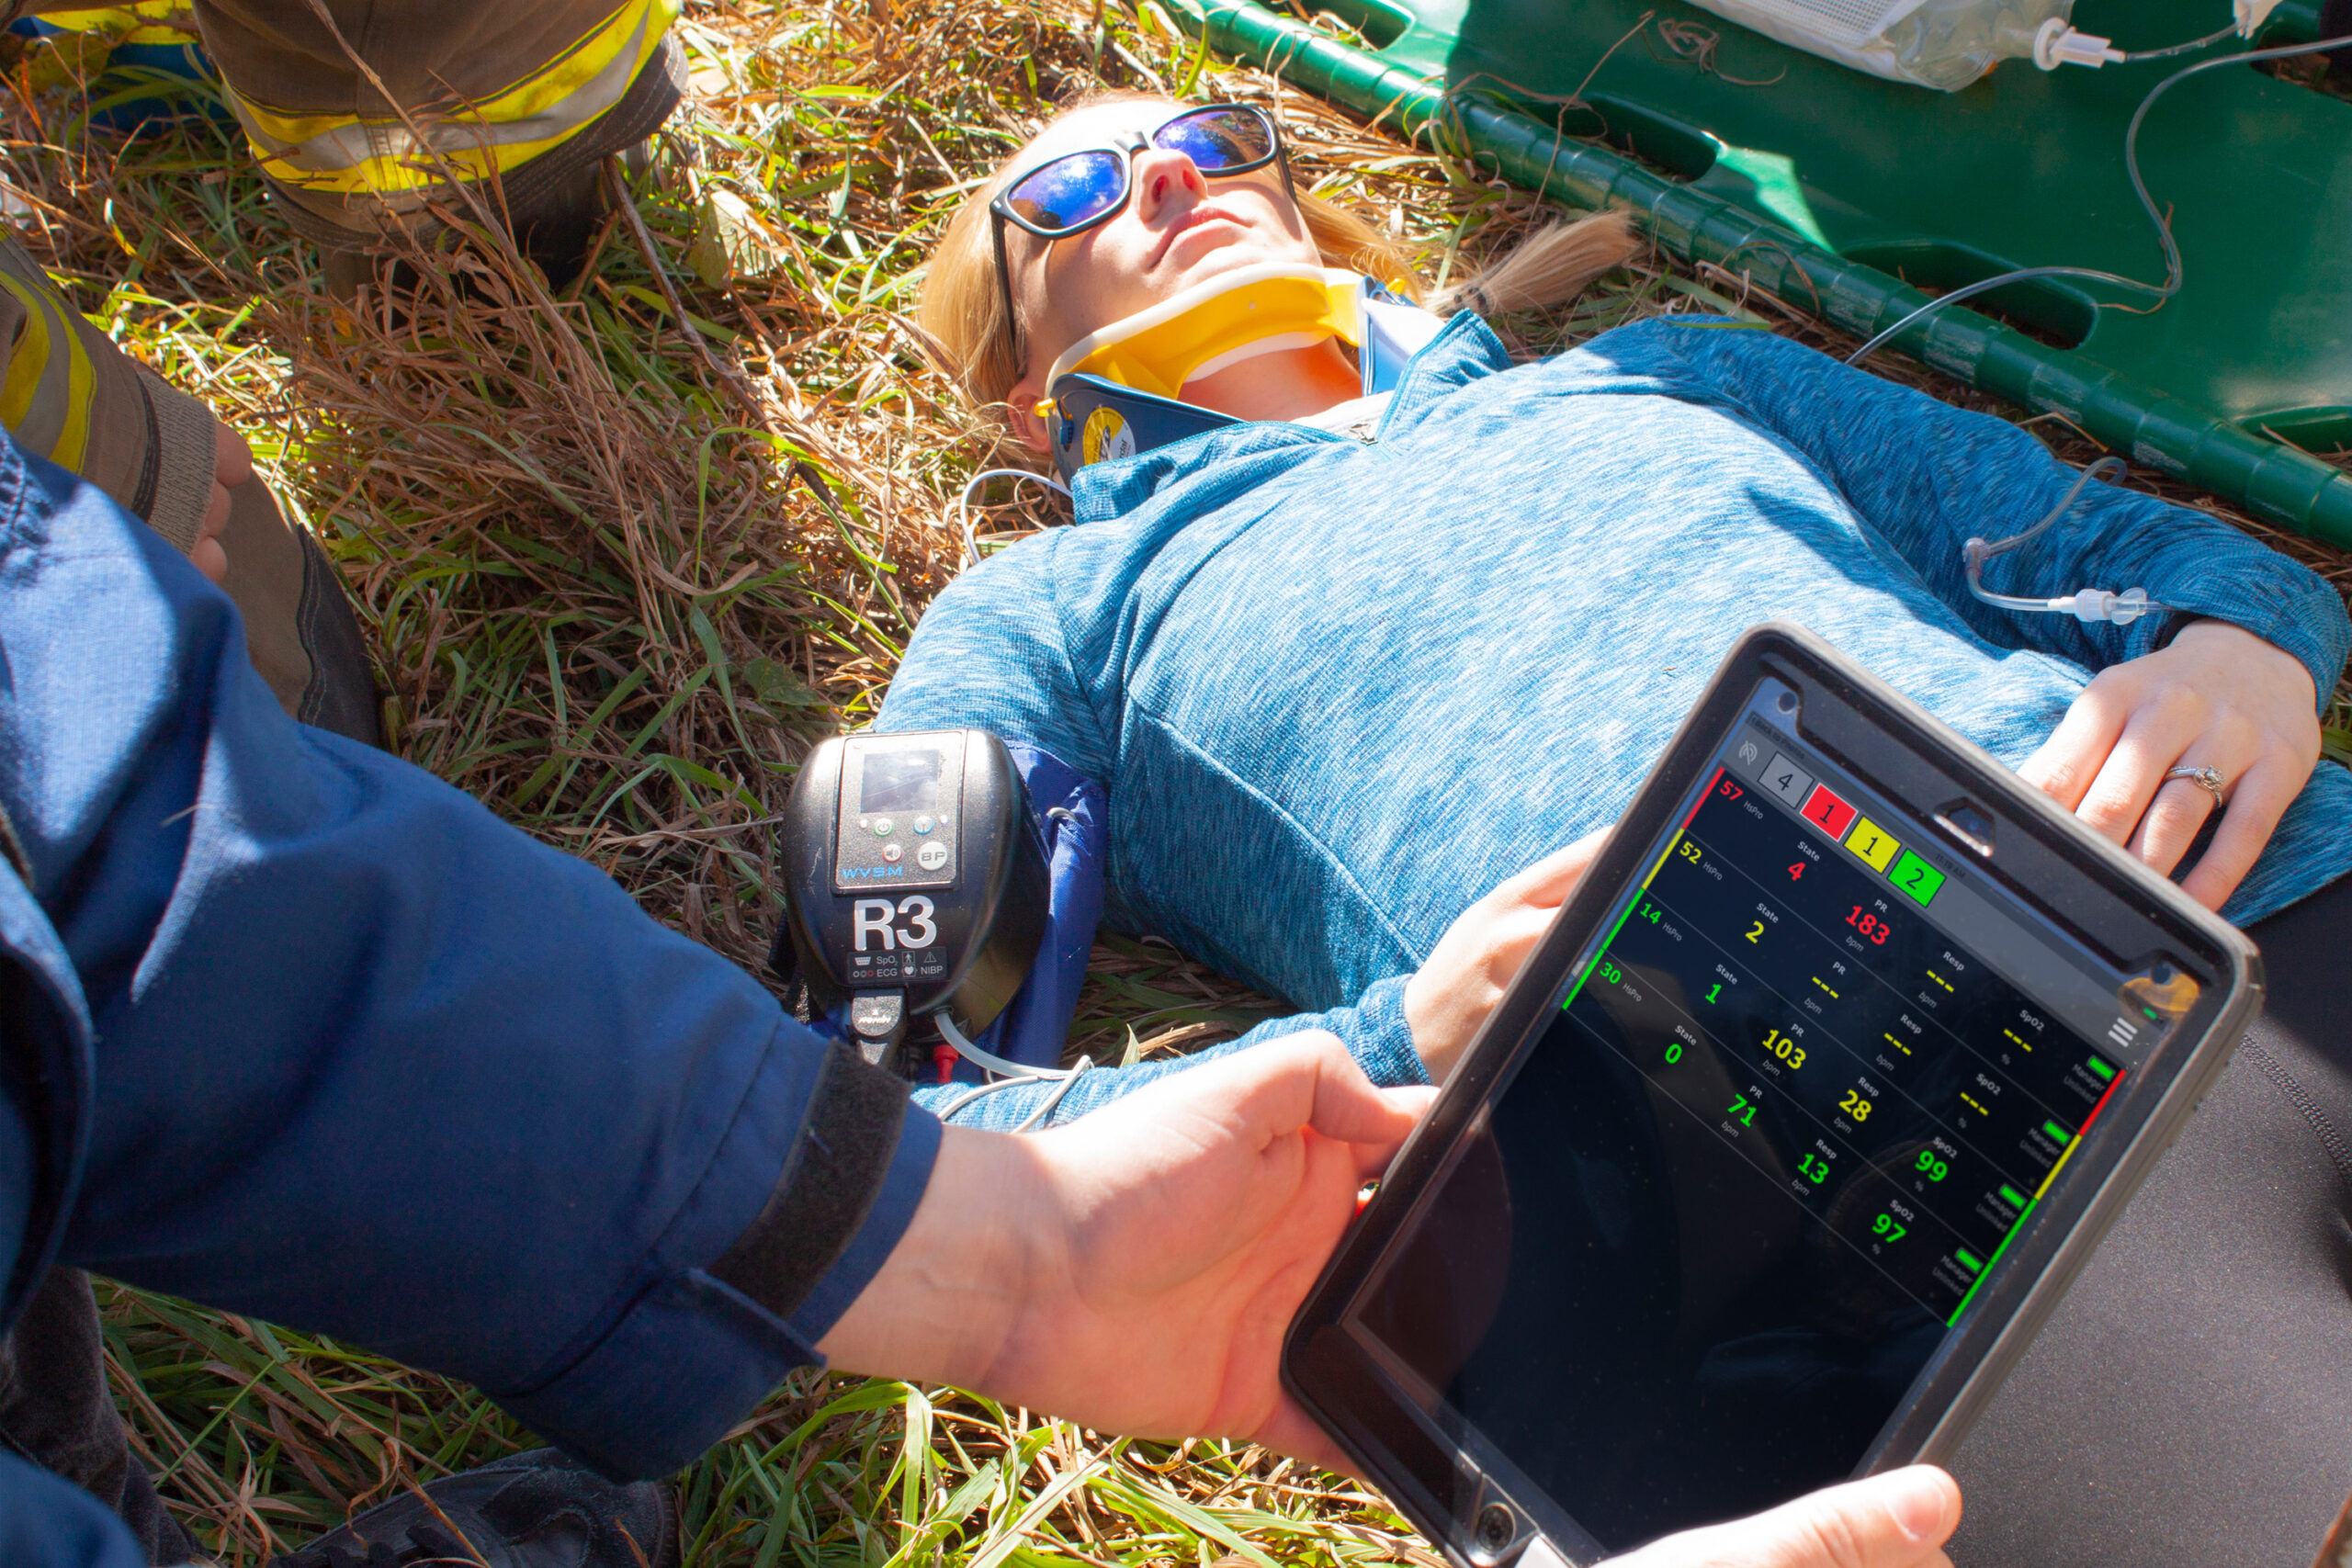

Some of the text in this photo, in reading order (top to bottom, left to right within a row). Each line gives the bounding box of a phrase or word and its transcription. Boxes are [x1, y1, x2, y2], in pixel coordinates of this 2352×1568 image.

[1778, 773, 1793, 792] 4
[1719, 780, 1763, 819] 57 HsPro
[1819, 804, 1835, 824] 1
[921, 851, 945, 862] BP
[1797, 840, 1820, 862] State
[1862, 837, 1879, 857] 1
[1679, 840, 1723, 881] 52 HsPro
[842, 865, 903, 880] WVSM
[1788, 862, 1806, 881] 4
[1905, 867, 1925, 890] 2
[1756, 903, 1779, 923] State
[1874, 899, 1888, 913] PR
[853, 895, 937, 952] R3
[1639, 903, 1682, 942] 14 HsPro
[1745, 920, 1765, 944] 2
[1845, 905, 1891, 945] 183
[1845, 935, 1864, 953] bpm
[921, 965, 944, 976] NIBP
[1832, 962, 1847, 976] PR
[1942, 951, 1965, 972] Resp
[876, 968, 898, 977] ECG
[1599, 962, 1642, 1002] 30 HsPro
[1715, 964, 1738, 985] State
[1705, 983, 1723, 1005] 1
[1918, 991, 1938, 1010] bpm
[1804, 998, 1822, 1015] bpm
[1791, 1023, 1804, 1037] PR
[1900, 1014, 1923, 1035] Resp
[2018, 1010, 2045, 1032] SpO2
[1675, 1025, 1697, 1046] State
[1665, 1043, 1683, 1064] 0
[1762, 1029, 1806, 1069] 103
[1762, 1059, 1781, 1077] bpm
[1875, 1054, 1894, 1072] bpm
[1858, 1076, 1880, 1098] Resp
[1975, 1072, 2001, 1096] SpO2
[2072, 1063, 2106, 1091] Manager
[1749, 1085, 1763, 1100] PR
[1727, 1093, 1757, 1128] 71
[1838, 1089, 1872, 1122] 28
[1721, 1121, 1739, 1138] bpm
[1833, 1116, 1852, 1134] bpm
[1815, 1139, 1838, 1160] Resp
[1932, 1136, 1958, 1159] SpO2
[1797, 1153, 1830, 1184] 13
[1915, 1150, 1949, 1182] 99
[1791, 1179, 1811, 1196] bpm
[1890, 1199, 1915, 1223] SpO2
[1871, 1213, 1906, 1243] 97
